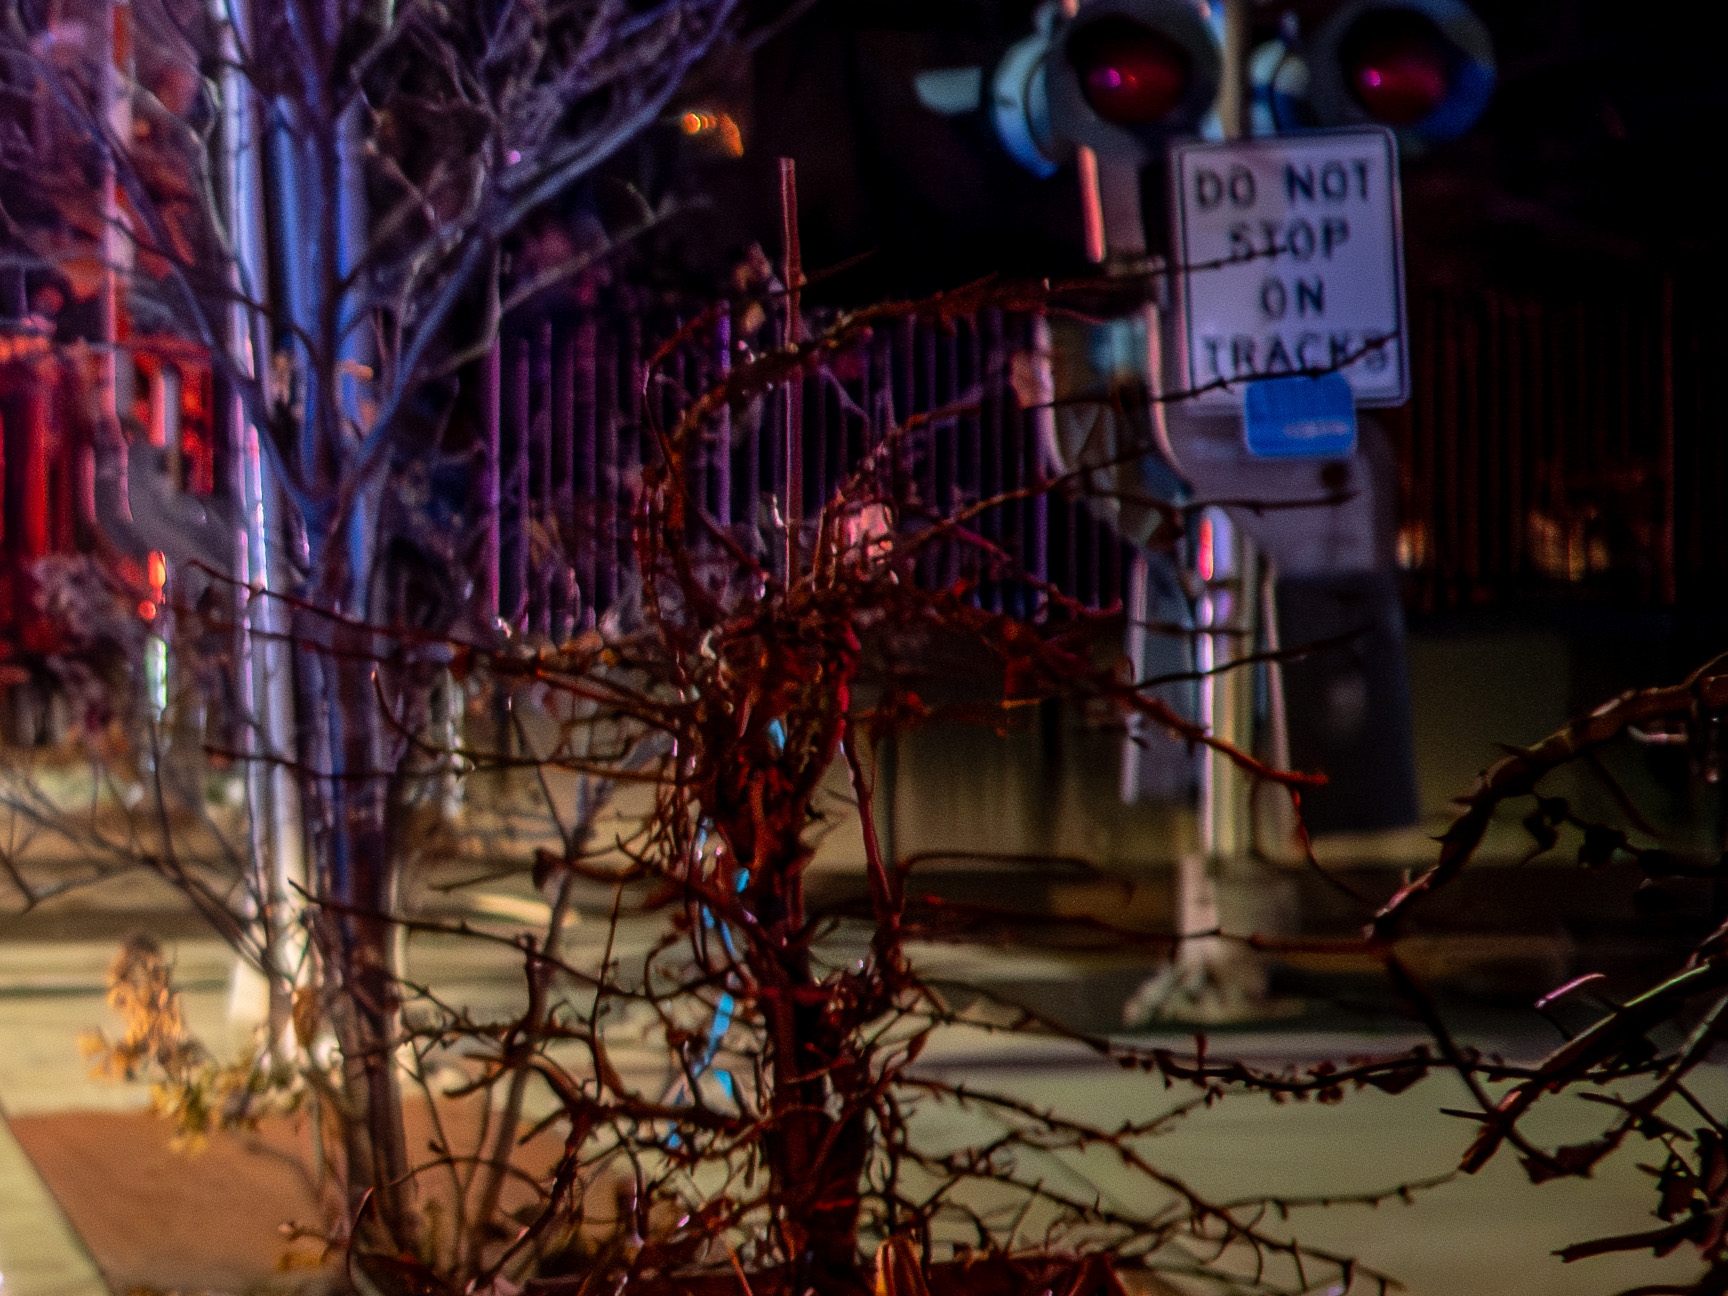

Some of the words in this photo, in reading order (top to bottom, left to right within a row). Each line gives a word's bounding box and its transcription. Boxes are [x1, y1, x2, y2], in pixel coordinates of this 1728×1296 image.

[1196, 165, 1255, 208] DO
[1285, 159, 1369, 203] NOT
[1229, 216, 1349, 261] STOP
[1260, 276, 1324, 321] ON
